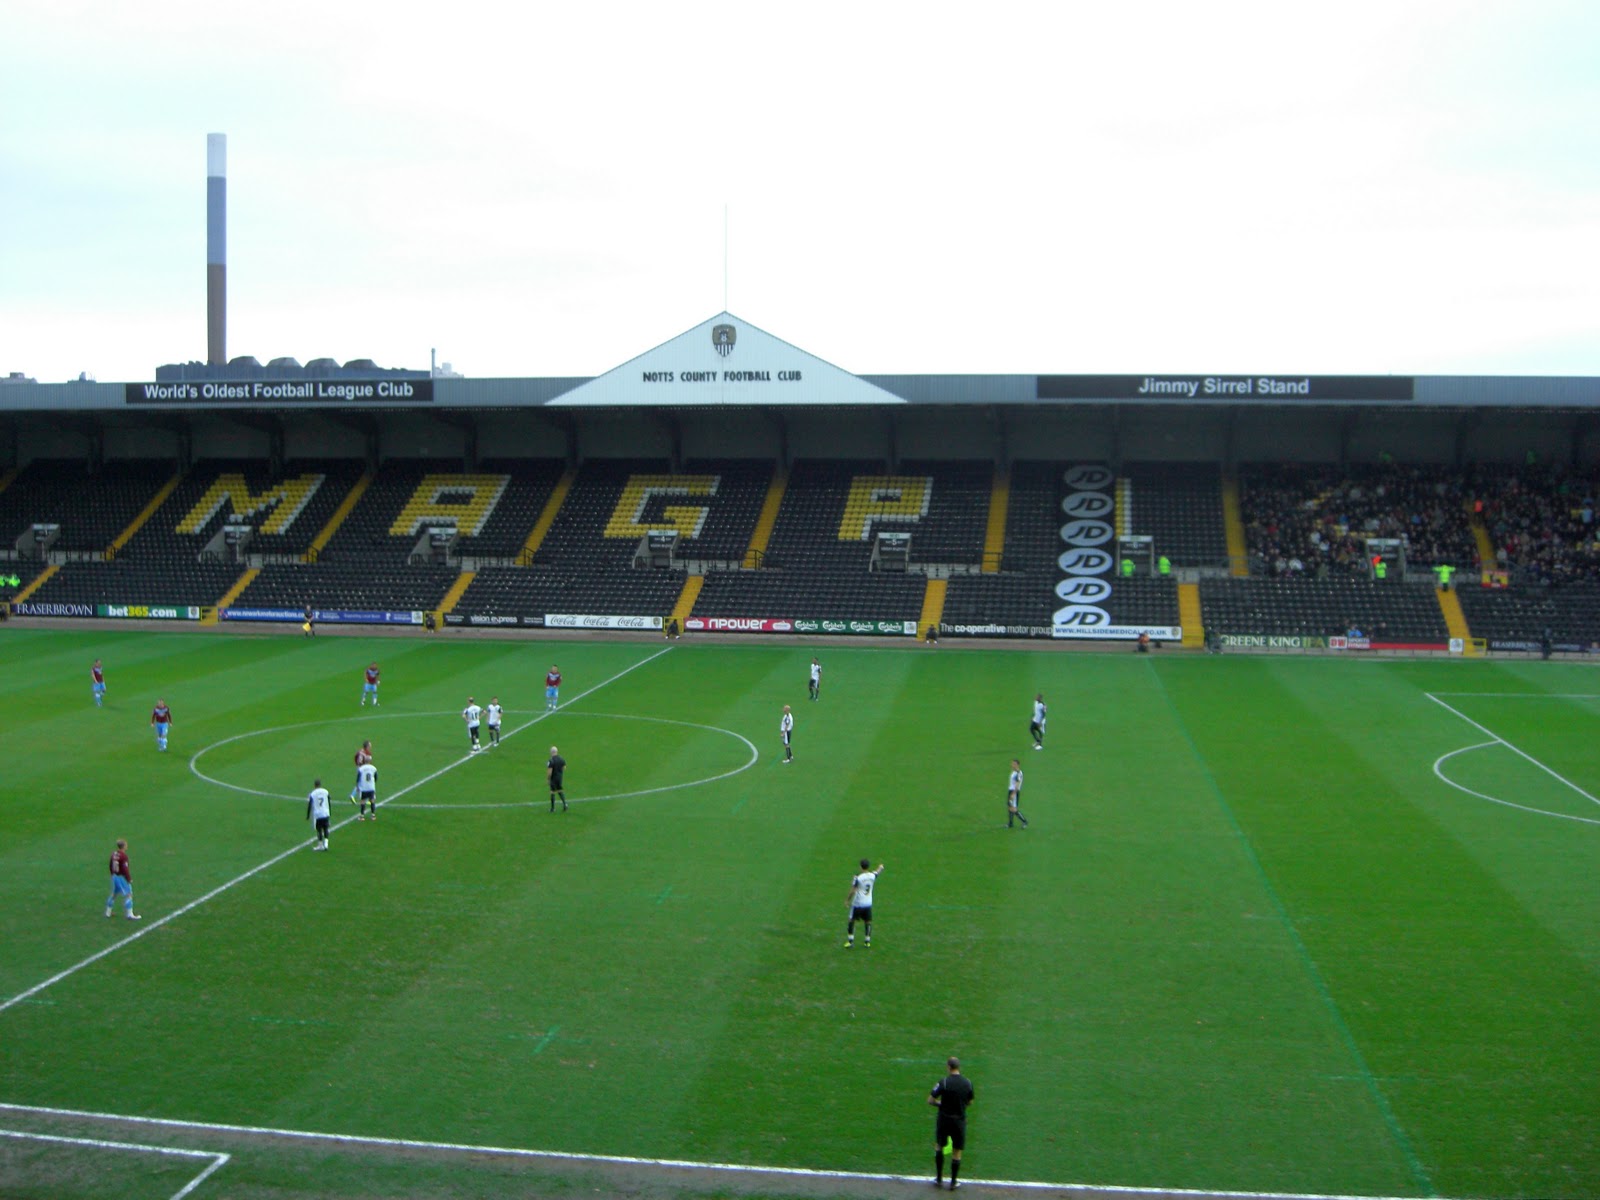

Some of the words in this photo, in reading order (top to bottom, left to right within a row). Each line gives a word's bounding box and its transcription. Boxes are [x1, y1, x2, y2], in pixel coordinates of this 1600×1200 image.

[642, 371, 675, 382] NOTTS
[680, 371, 717, 382] COUNTY
[723, 371, 771, 381] FOOTBALL
[777, 370, 802, 381] CLUB
[144, 383, 198, 399] World's
[202, 382, 250, 398] Oldest
[253, 382, 314, 398] Football
[318, 382, 374, 400] League
[377, 381, 414, 397] Club
[1138, 378, 1199, 397] Jimmy
[1204, 378, 1252, 394] Sirrel
[1257, 378, 1310, 394] Stand
[1071, 470, 1108, 484] JD
[1069, 497, 1107, 511] JD
[1067, 525, 1107, 539] JD
[1065, 554, 1106, 569] JD
[1063, 583, 1105, 597] JD
[17, 603, 93, 616] FRASERBROWN
[108, 604, 178, 618] bet365.com
[470, 614, 490, 623] vision
[1060, 611, 1104, 625] JD
[794, 620, 819, 631] Carlsberg
[822, 620, 846, 631] Carlsberg
[850, 621, 874, 631] Carlsberg
[878, 621, 902, 632] Carlsberg
[940, 623, 954, 633] The
[955, 623, 1006, 634] co-operative
[1008, 626, 1029, 634] motor
[1031, 626, 1053, 636] group
[1221, 635, 1267, 647] GREENE
[1269, 636, 1300, 647] KING
